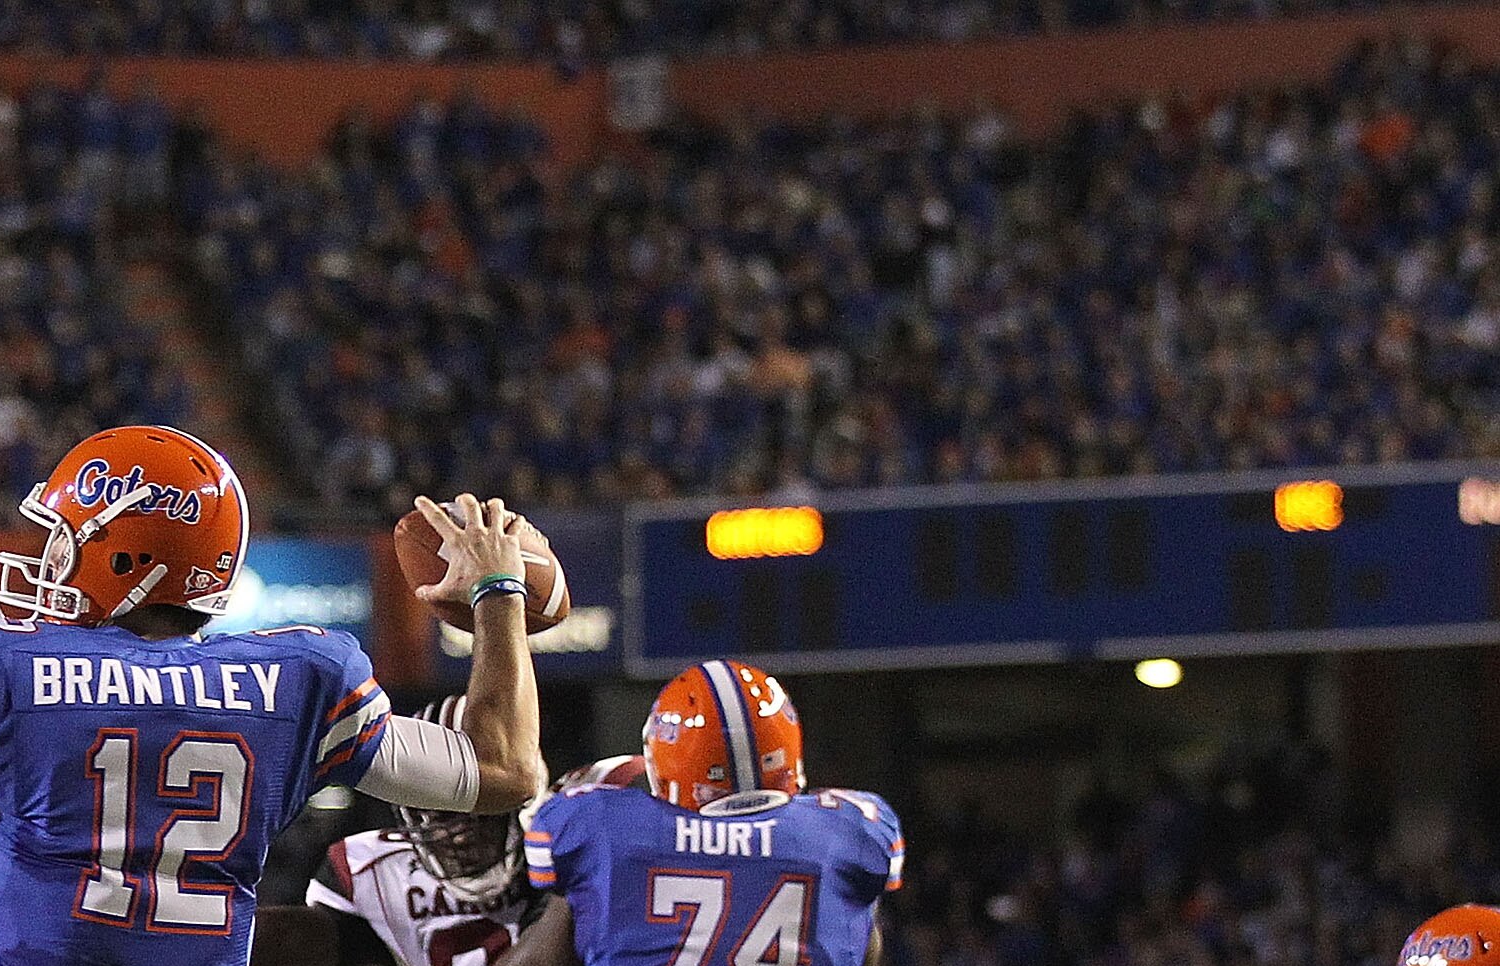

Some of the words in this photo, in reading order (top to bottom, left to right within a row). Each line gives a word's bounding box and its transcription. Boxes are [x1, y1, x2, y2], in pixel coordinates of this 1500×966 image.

[32, 656, 281, 713] BRANTLEY
[72, 727, 256, 936] 12
[675, 814, 779, 858] HURT
